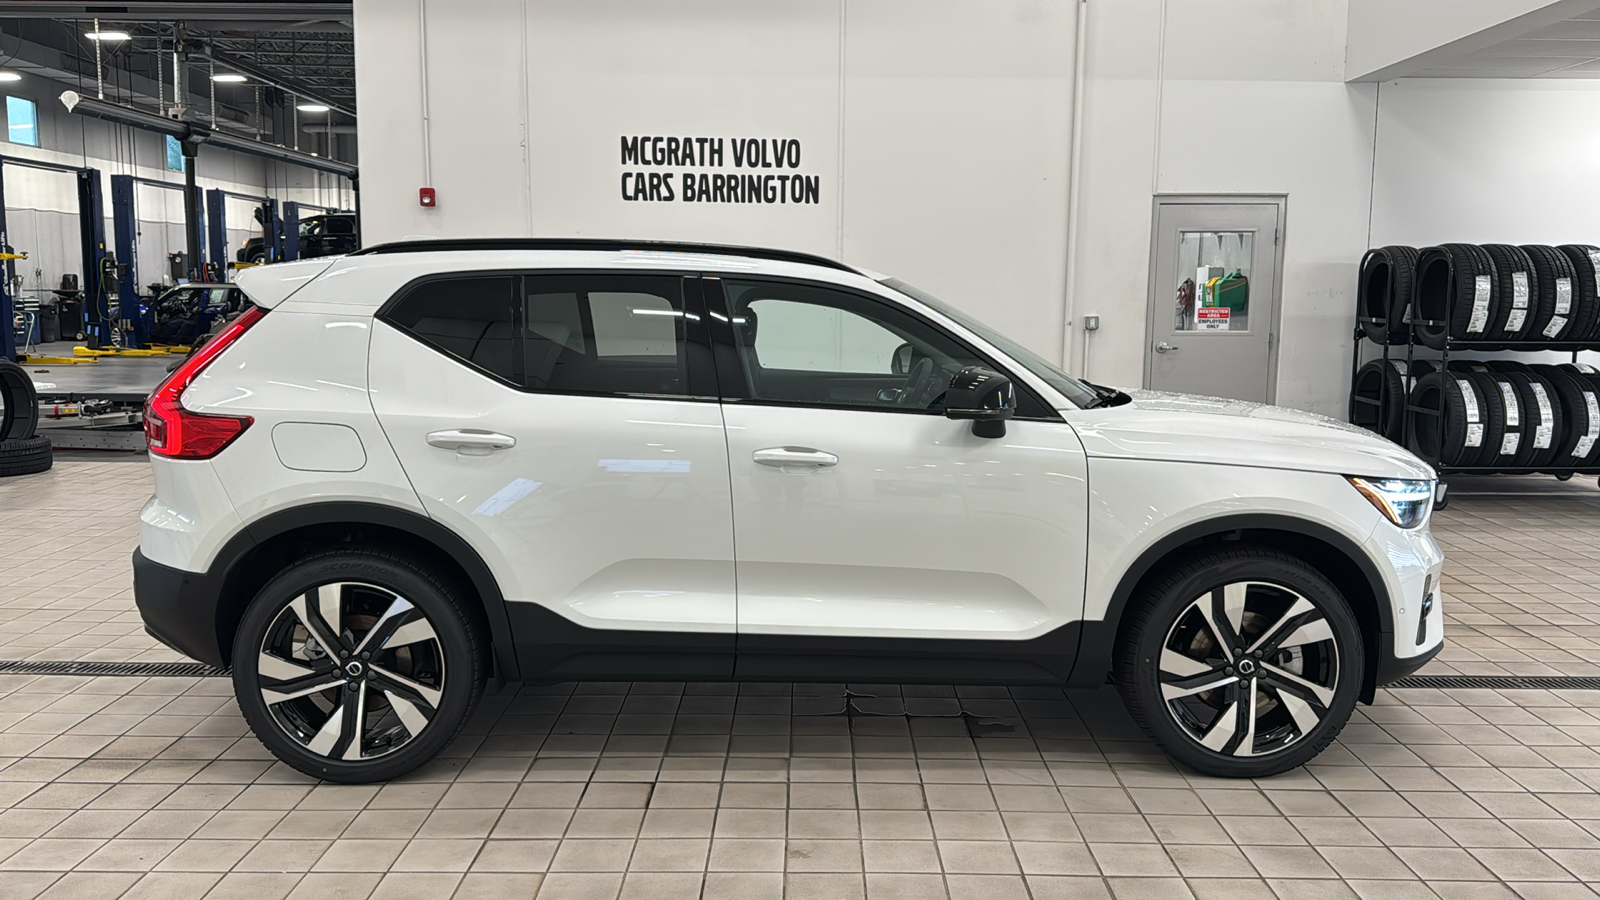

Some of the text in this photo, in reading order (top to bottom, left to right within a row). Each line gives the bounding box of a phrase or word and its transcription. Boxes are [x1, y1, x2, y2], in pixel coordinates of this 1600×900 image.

[621, 136, 801, 168] MCGRATH VOLVO
[622, 172, 819, 204] CARS BARRINGTON
